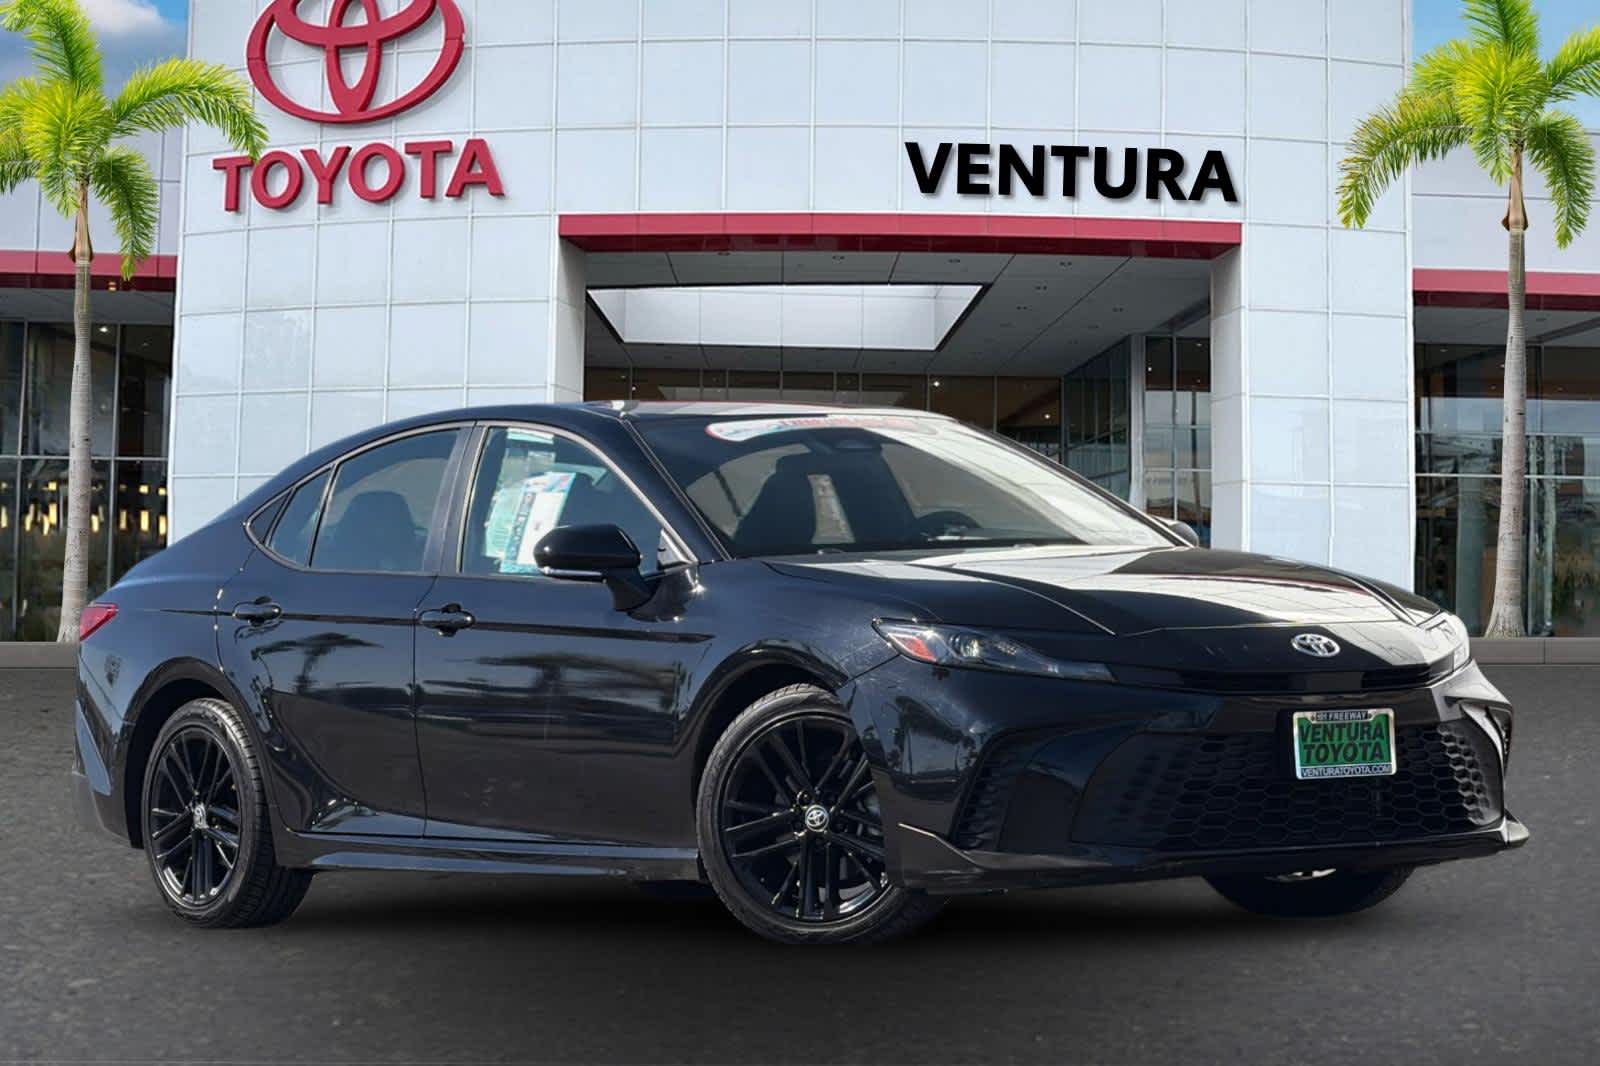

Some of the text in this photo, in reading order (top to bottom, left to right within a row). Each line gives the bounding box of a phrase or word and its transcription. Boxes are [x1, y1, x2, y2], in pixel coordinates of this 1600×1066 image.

[213, 138, 505, 212] TOYOTA
[904, 141, 1238, 203] VENTURA
[1329, 711, 1366, 721] FREEWAY
[1299, 720, 1384, 742] VENTURA
[1303, 741, 1384, 763] TOYOTA
